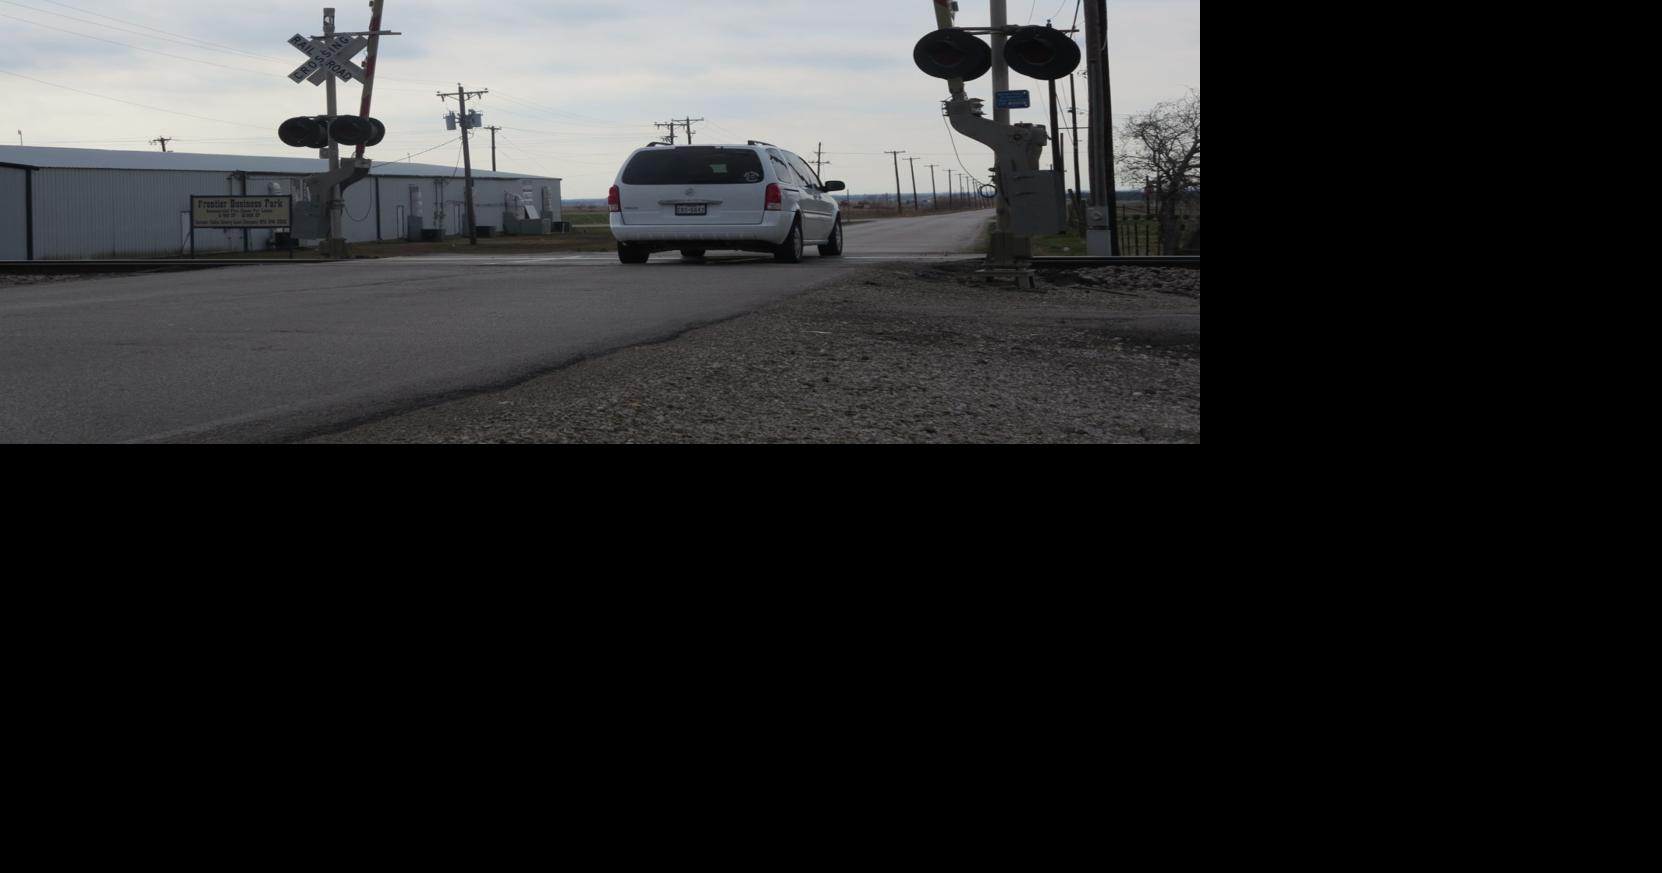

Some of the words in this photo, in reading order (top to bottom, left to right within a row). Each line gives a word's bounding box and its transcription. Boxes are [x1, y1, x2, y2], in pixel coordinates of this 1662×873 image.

[291, 36, 314, 56] RAIL
[327, 60, 353, 80] ROAD
[293, 36, 349, 80] CROSSING
[198, 199, 227, 209] Frontier
[230, 199, 262, 209] Business
[264, 198, 283, 209] Park
